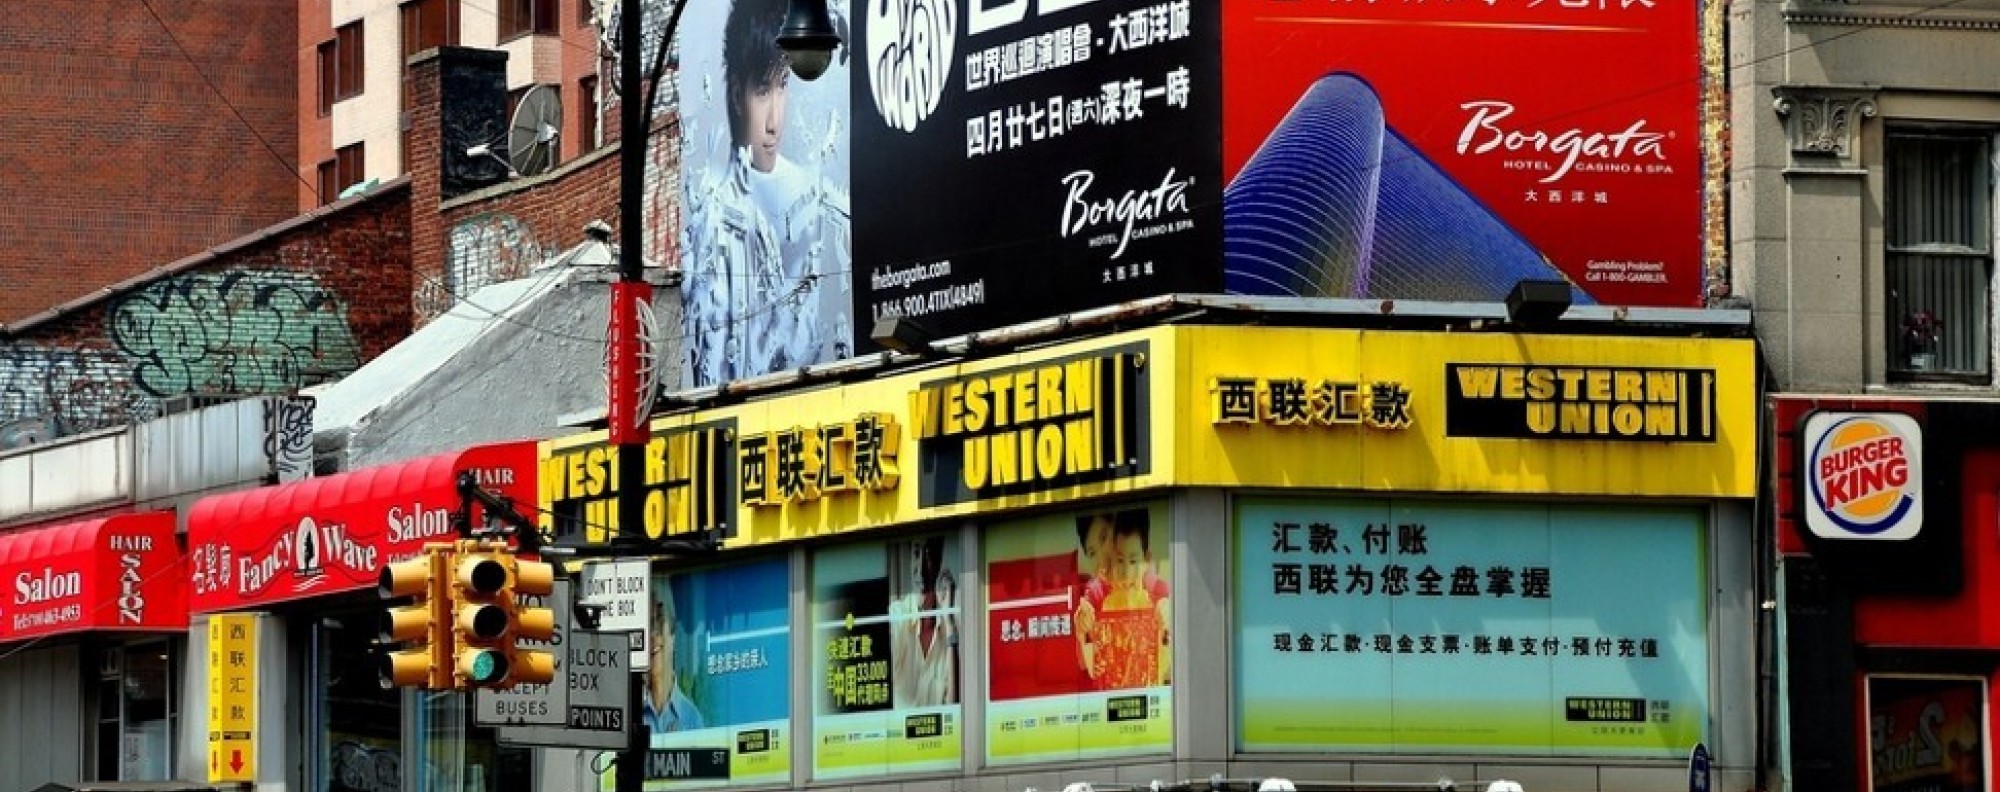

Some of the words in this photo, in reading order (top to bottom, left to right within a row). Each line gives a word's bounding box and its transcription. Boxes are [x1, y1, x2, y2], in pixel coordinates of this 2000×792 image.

[1457, 100, 1667, 183] Borgata
[1503, 160, 1551, 171] HOTEL
[1575, 162, 1630, 173] CASINO
[1633, 163, 1643, 173] &
[1645, 164, 1674, 174] SPA
[1061, 166, 1189, 260] Borgata
[612, 289, 621, 437] FLUSHING
[1456, 366, 1678, 402] WESTERN
[909, 358, 1094, 440] WESTERN
[1213, 378, 1412, 429] 西联汇款
[1526, 402, 1677, 436] UNION
[540, 431, 691, 501] WESTRN
[740, 412, 886, 504] 西联汇款
[964, 416, 1094, 490] UNION
[1820, 437, 1904, 480] BURGER
[1826, 458, 1908, 511] KING
[388, 503, 448, 544] Salon
[585, 486, 691, 543] UON
[111, 535, 153, 551] HAIR
[239, 531, 294, 594] Fancy
[322, 524, 377, 572] Wave
[1272, 523, 1427, 555] 汇款、付账
[13, 567, 81, 606] Salon
[118, 553, 145, 624] SALON
[617, 576, 644, 594] BLOCK
[1273, 563, 1552, 598] 西联为您全盘掌握
[618, 599, 636, 617] BOX
[496, 700, 548, 715] BUSES
[571, 707, 621, 728] POINTS
[653, 753, 691, 776] MAIN
